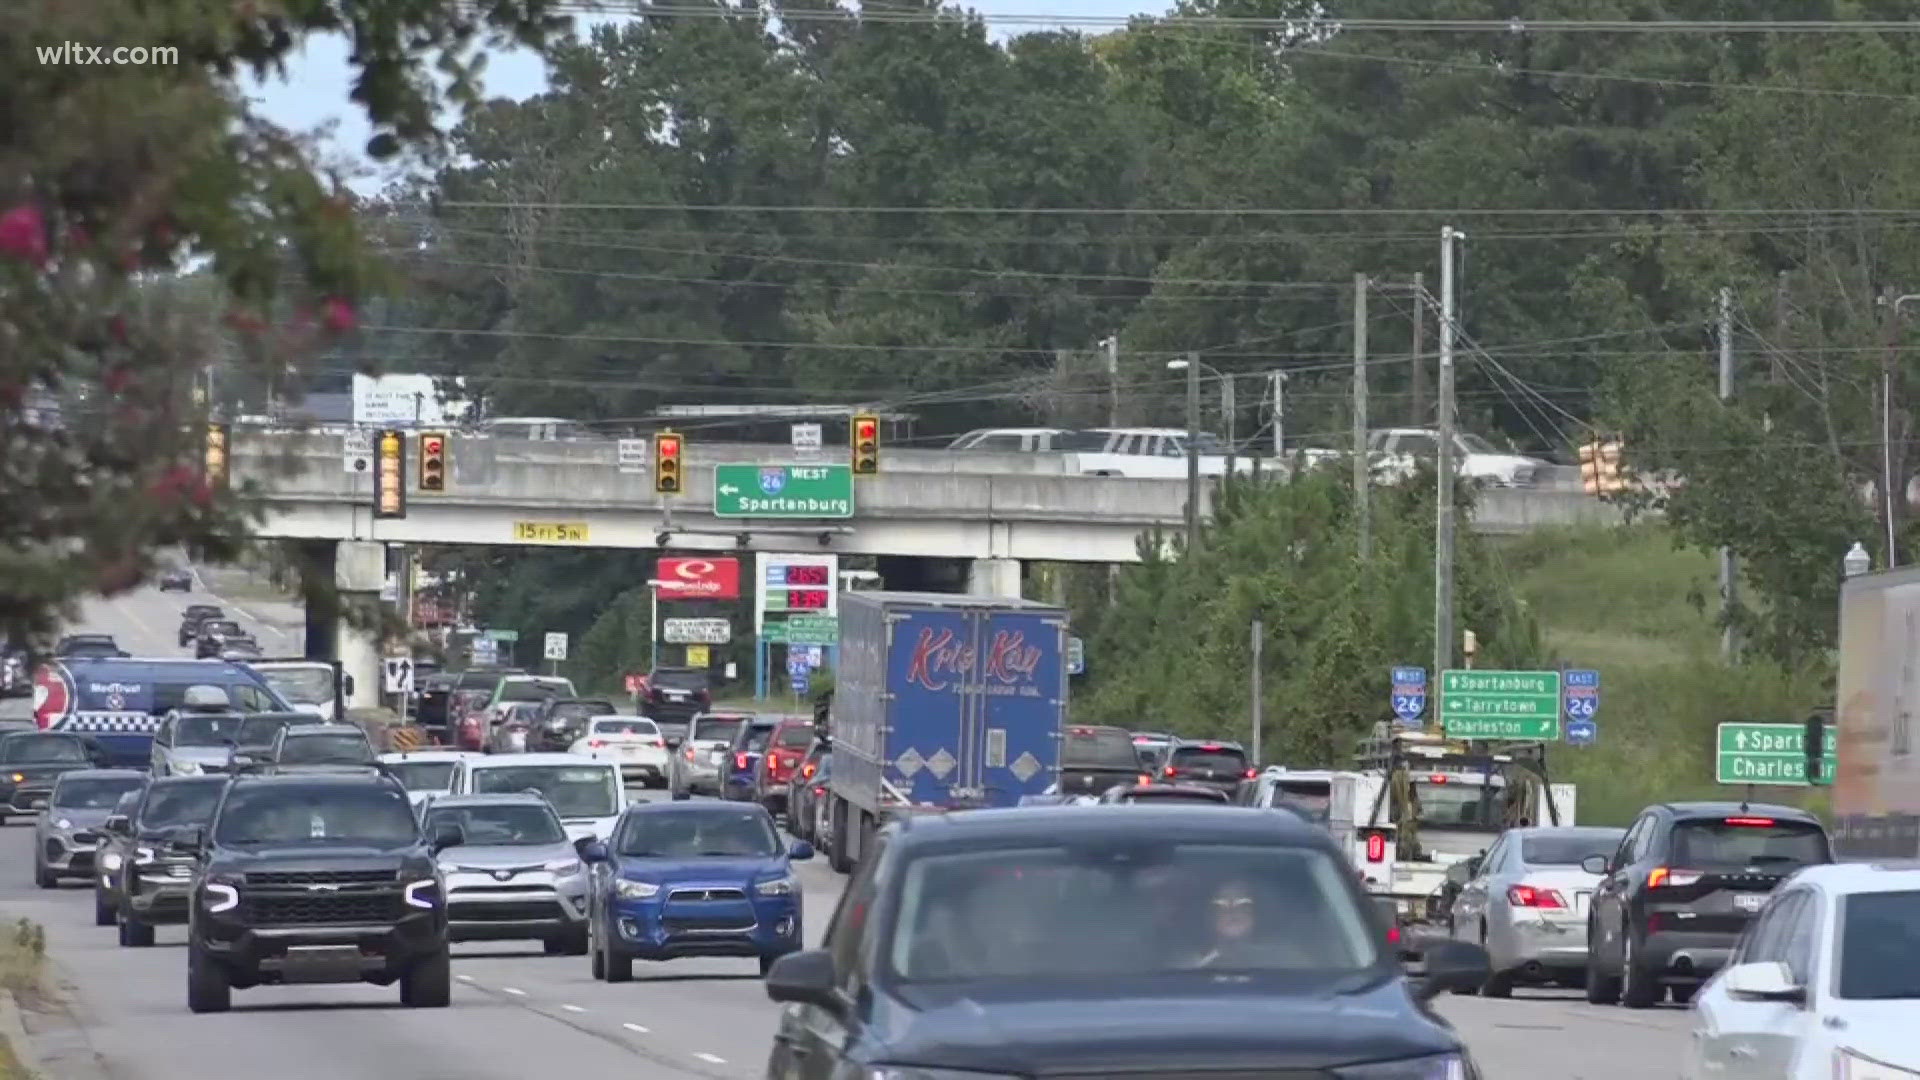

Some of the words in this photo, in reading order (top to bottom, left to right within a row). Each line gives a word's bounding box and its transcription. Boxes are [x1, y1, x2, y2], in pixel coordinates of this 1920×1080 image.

[791, 467, 828, 480] WEST
[762, 475, 781, 489] 26
[738, 497, 848, 514] Spartanburg
[519, 523, 536, 539] 15
[557, 524, 567, 539] 5
[1461, 675, 1545, 692] Spartanburg
[1398, 697, 1420, 713] 26
[1465, 699, 1537, 715] Tarrytown
[1569, 699, 1594, 715] 26
[1447, 717, 1522, 733] Charleston
